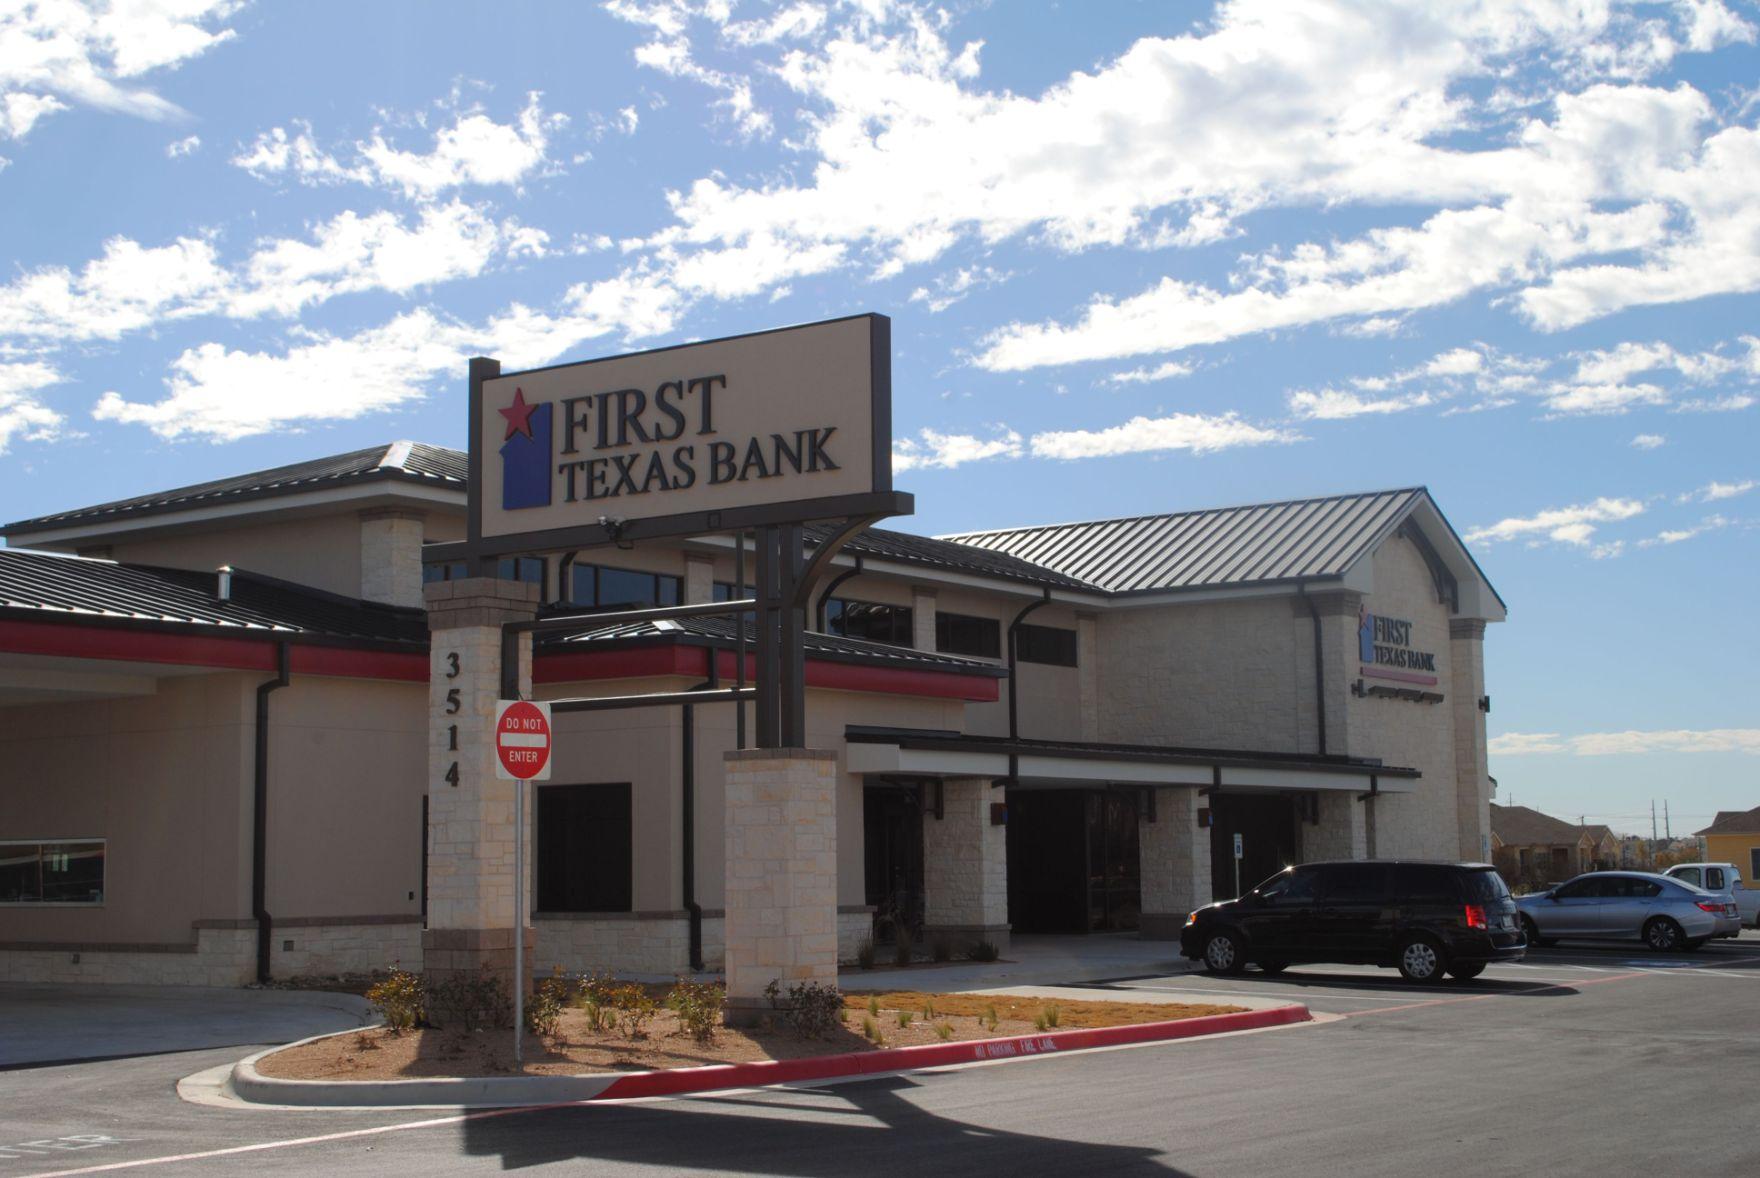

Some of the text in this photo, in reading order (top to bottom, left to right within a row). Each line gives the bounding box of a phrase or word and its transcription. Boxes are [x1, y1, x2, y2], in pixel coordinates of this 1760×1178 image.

[559, 374, 727, 455] FIRST
[558, 426, 842, 503] TEXAS BANK
[1373, 615, 1413, 647] FIRST
[1373, 645, 1436, 672] TEXAS BANK
[445, 651, 461, 787] 3514
[506, 717, 542, 730] DO NOT
[509, 751, 538, 763] ENTER
